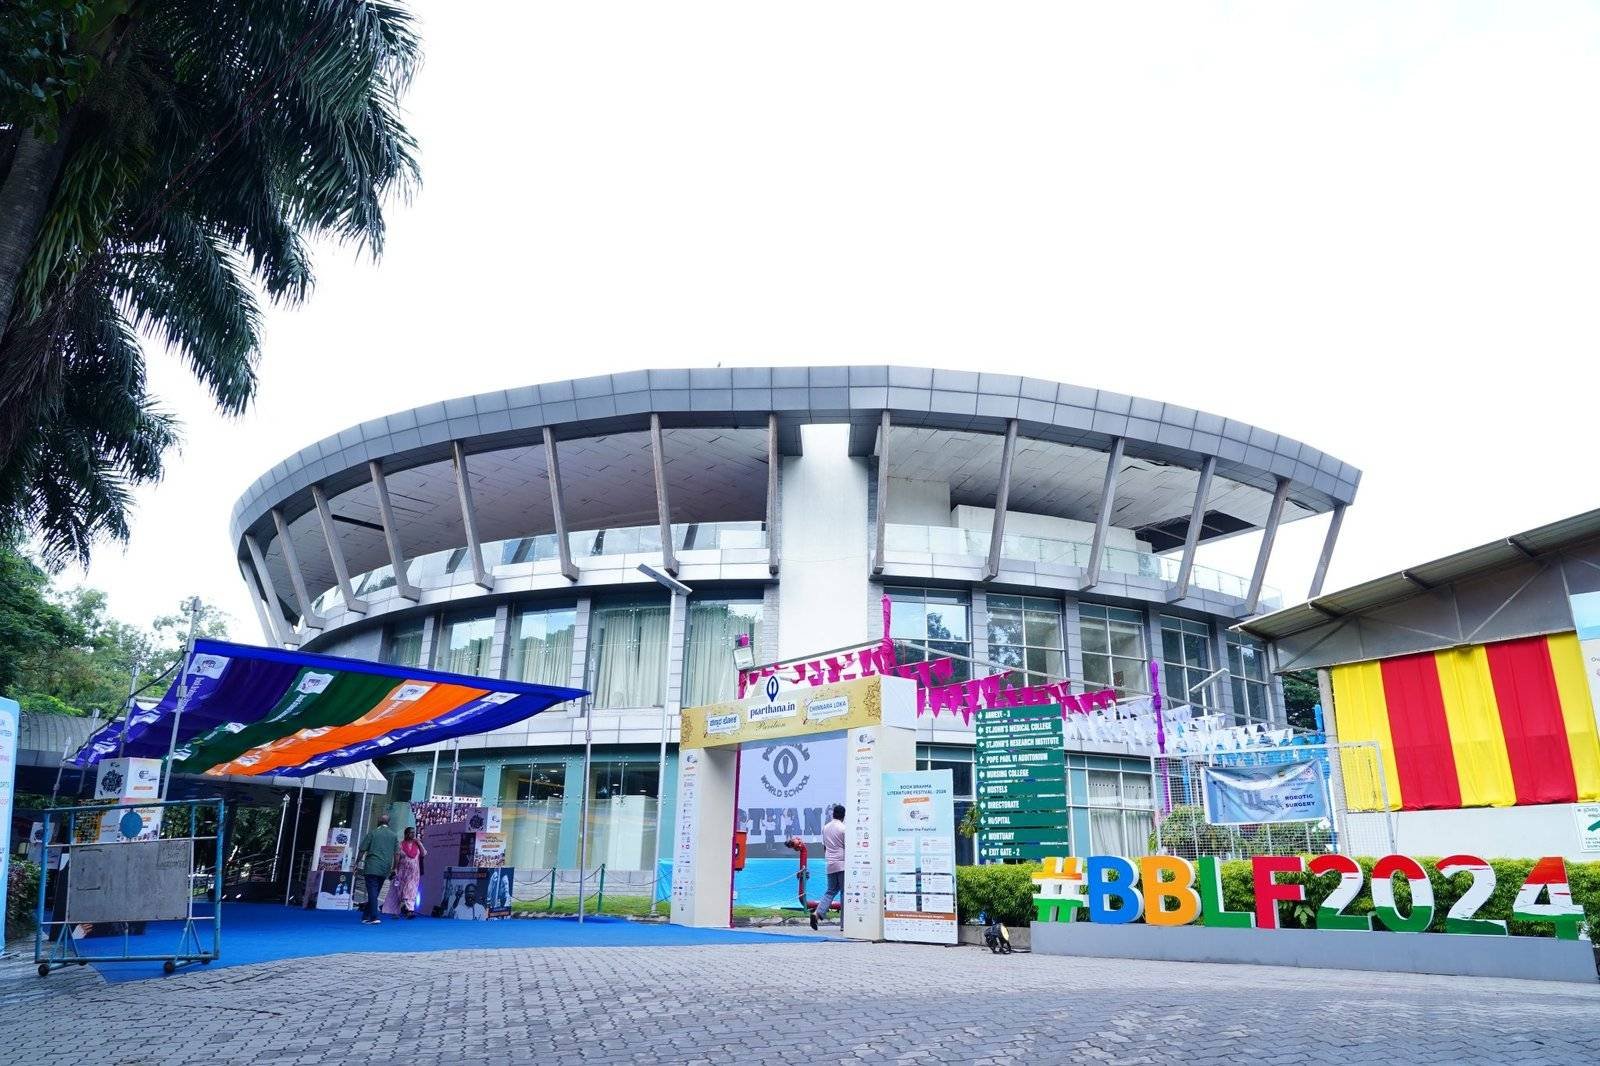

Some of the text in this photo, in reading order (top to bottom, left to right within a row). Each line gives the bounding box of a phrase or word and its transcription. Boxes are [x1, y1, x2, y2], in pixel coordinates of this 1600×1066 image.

[1009, 724, 1030, 732] MEDICAL
[1031, 722, 1052, 730] COLLEGE
[1010, 739, 1034, 747] RESEARCH
[1035, 737, 1059, 745] INSTITUTE
[986, 756, 998, 764] POPE
[1018, 753, 1048, 761] AUDITORIUM
[760, 774, 810, 798] WORLD SCHOOL
[986, 786, 1008, 794] HOSTELS
[988, 832, 1014, 840] MORTUARY
[989, 848, 999, 856] EXIT
[1032, 854, 1585, 940] #BBLF2024
